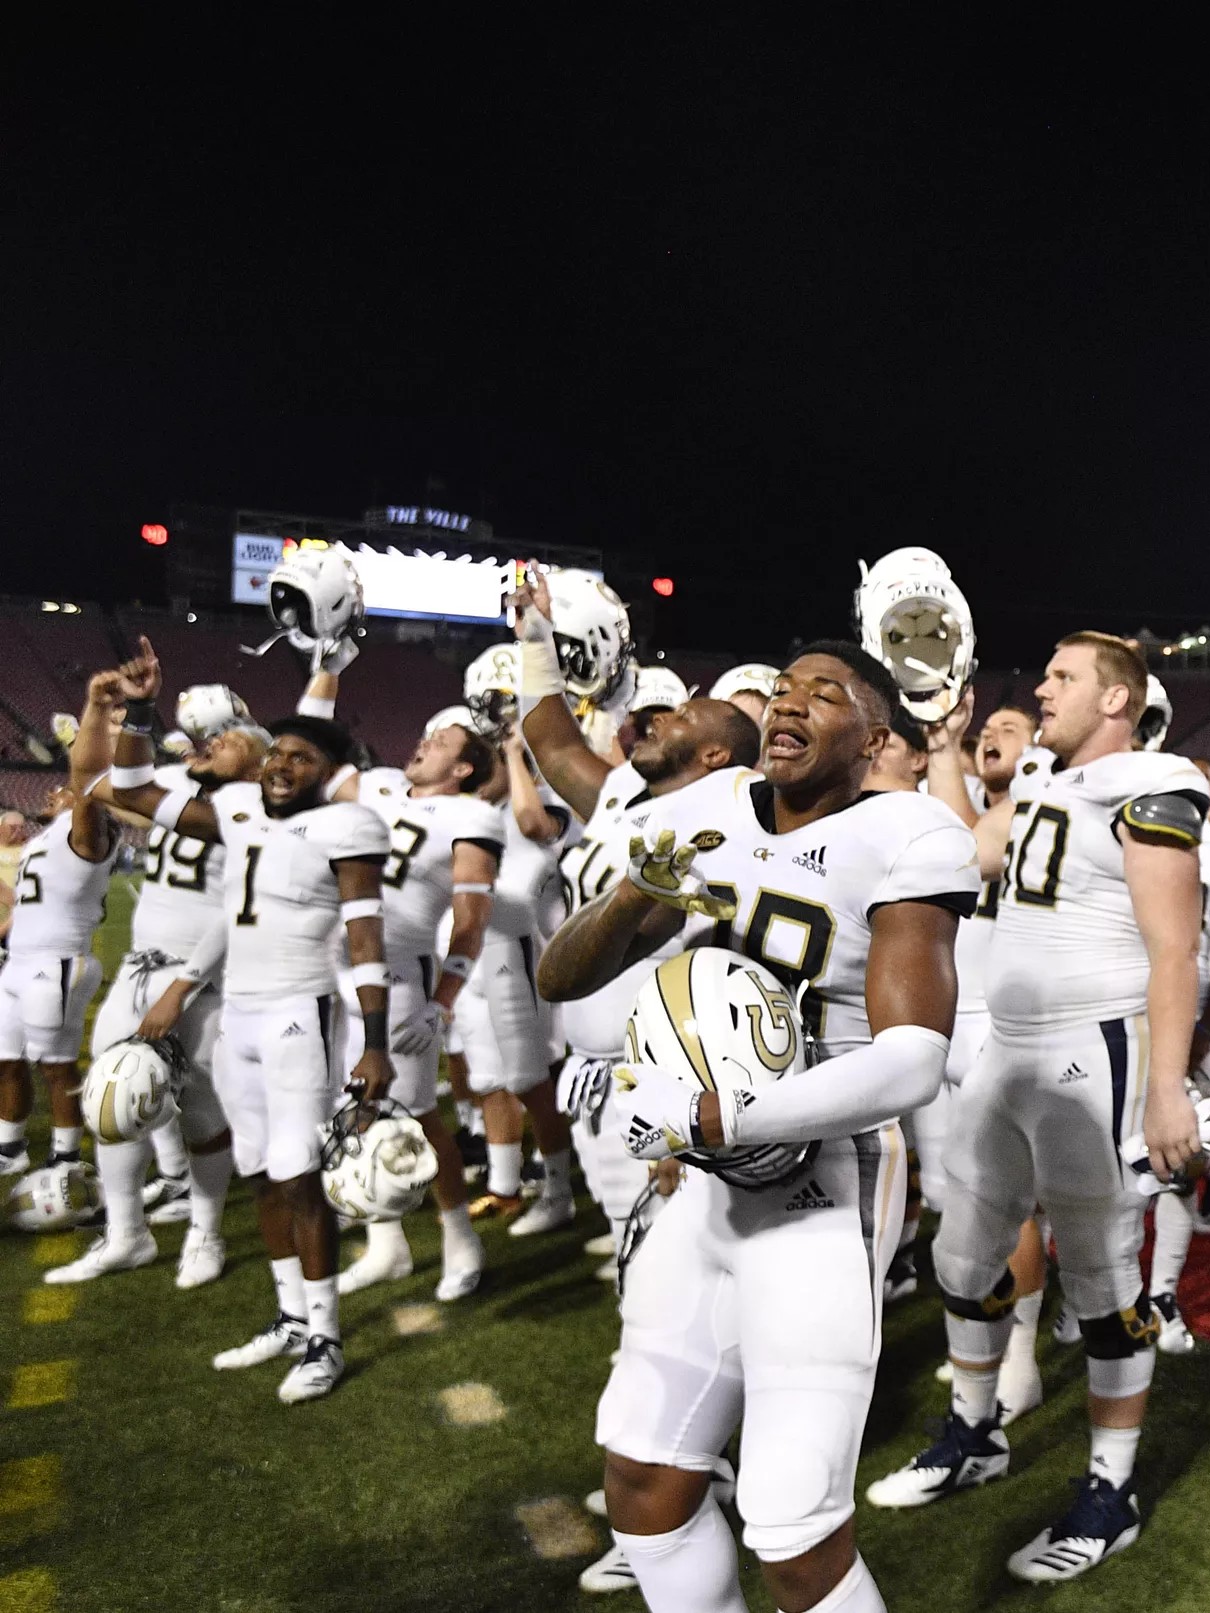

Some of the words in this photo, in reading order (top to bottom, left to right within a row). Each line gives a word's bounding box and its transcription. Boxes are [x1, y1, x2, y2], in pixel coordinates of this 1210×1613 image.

[387, 505, 420, 525] THE
[423, 508, 472, 532] VILLE
[791, 855, 827, 877] adidas
[235, 845, 264, 927] 1
[630, 1127, 666, 1154] adidas
[786, 1198, 835, 1211] adidas
